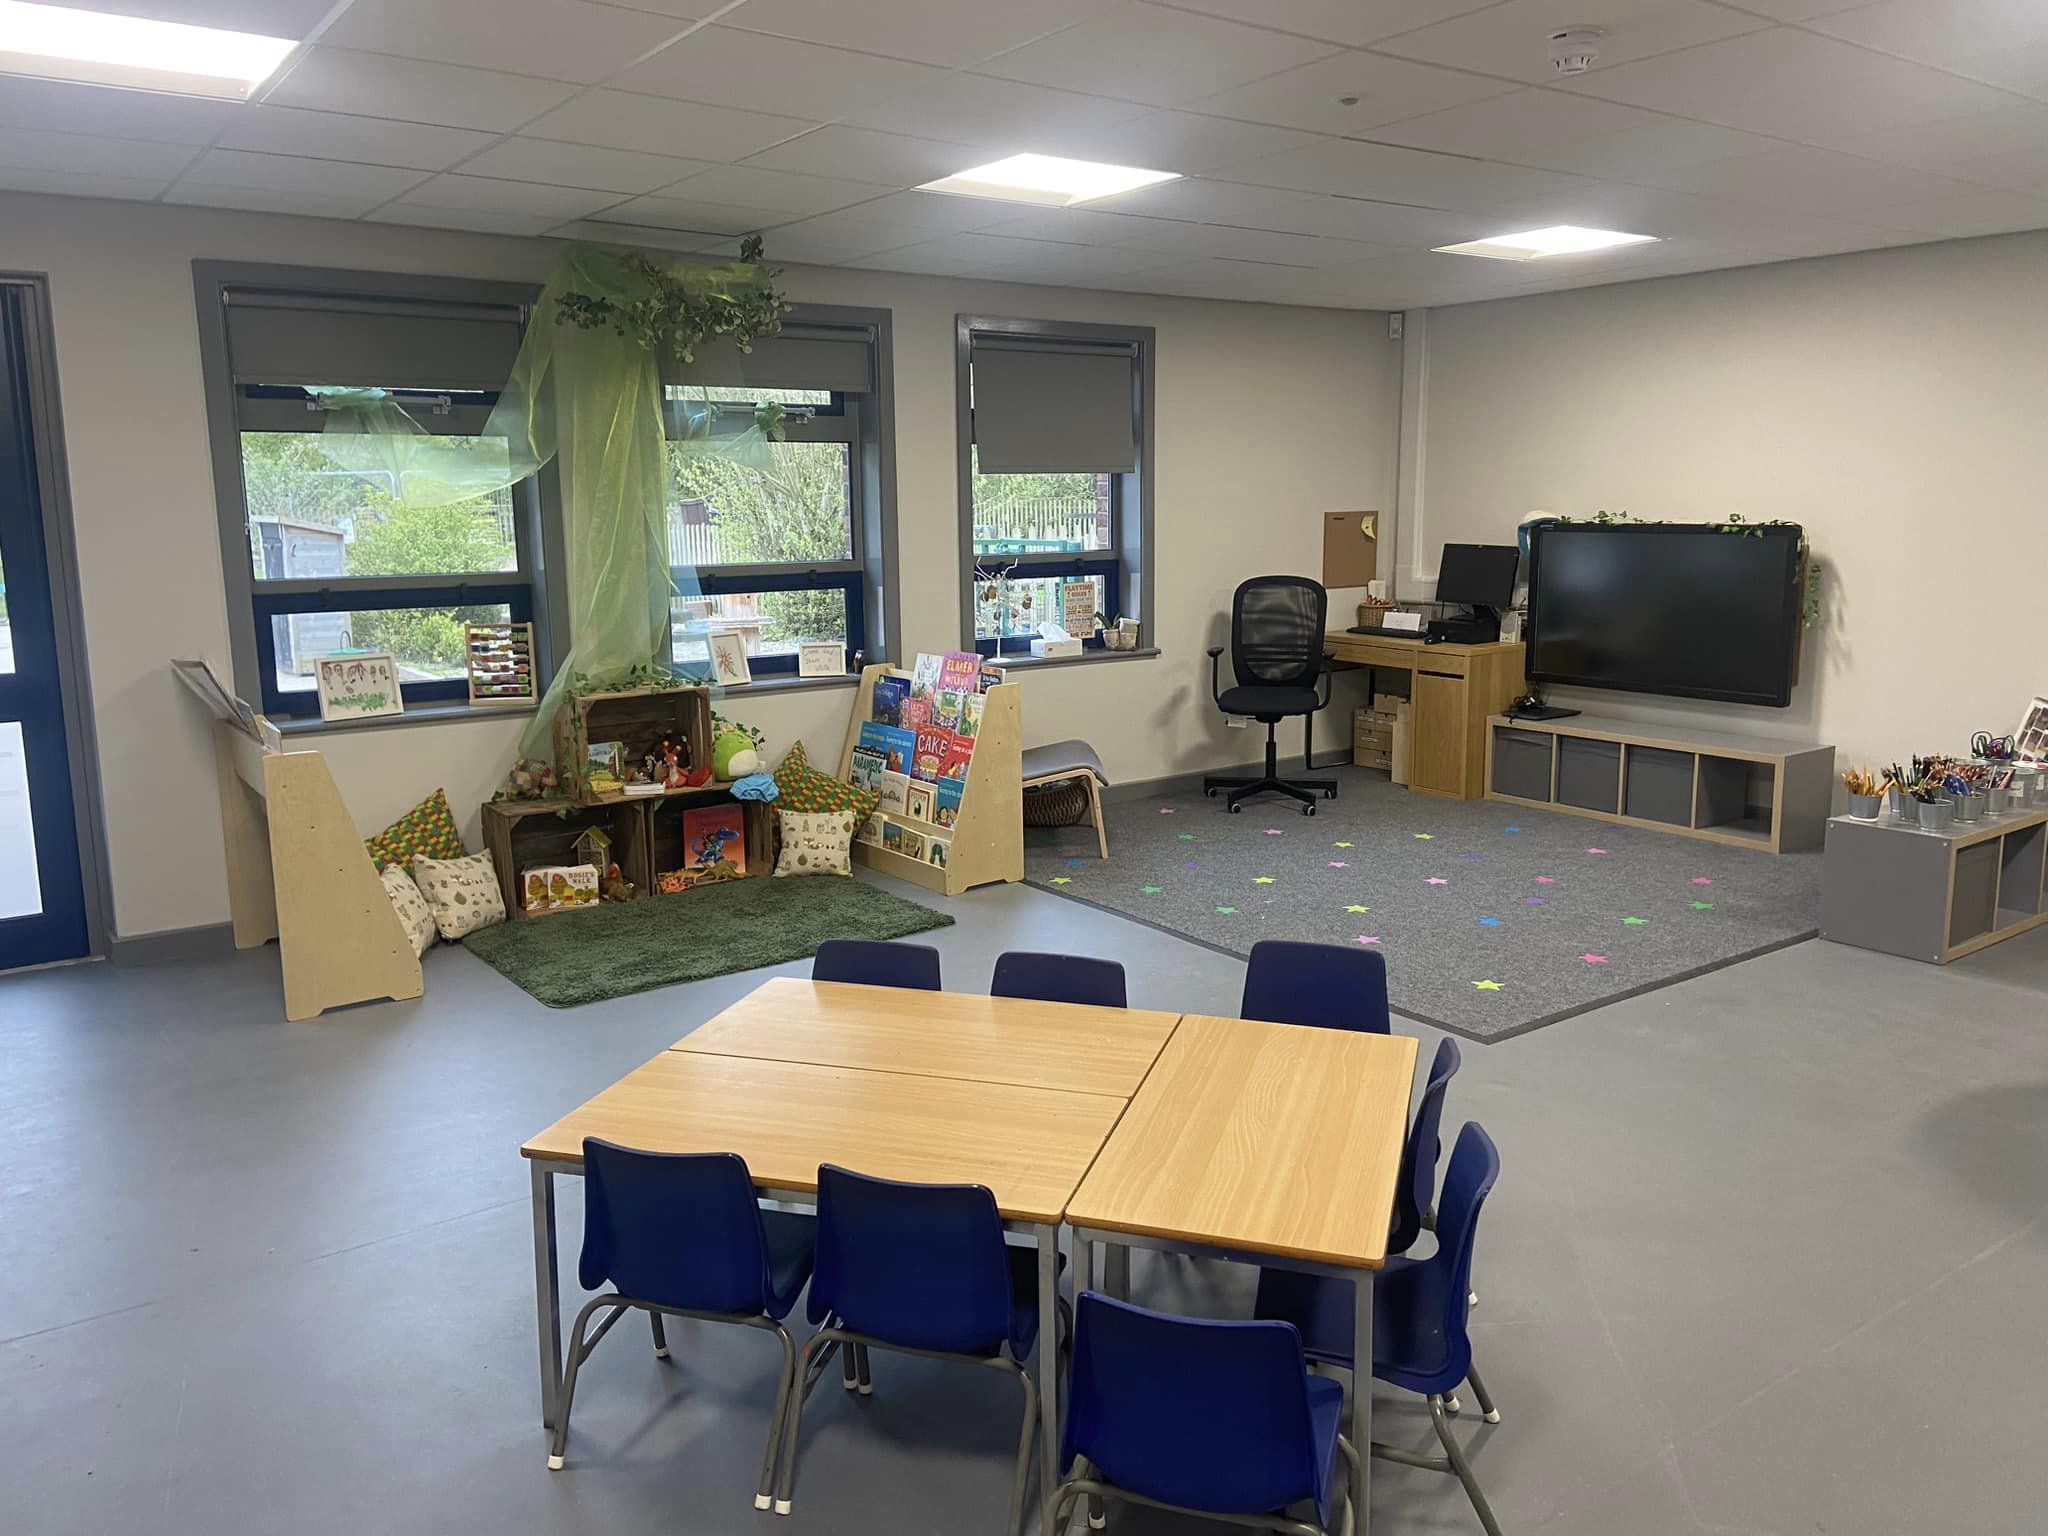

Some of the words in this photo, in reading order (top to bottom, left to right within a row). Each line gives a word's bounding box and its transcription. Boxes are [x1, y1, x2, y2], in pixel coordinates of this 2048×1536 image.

[1065, 583, 1093, 592] PLAYTIME
[946, 659, 974, 674] ELMER
[917, 734, 948, 757] CAKE
[853, 754, 884, 774] PARAMEDIC
[568, 871, 595, 879] ROSIE'S
